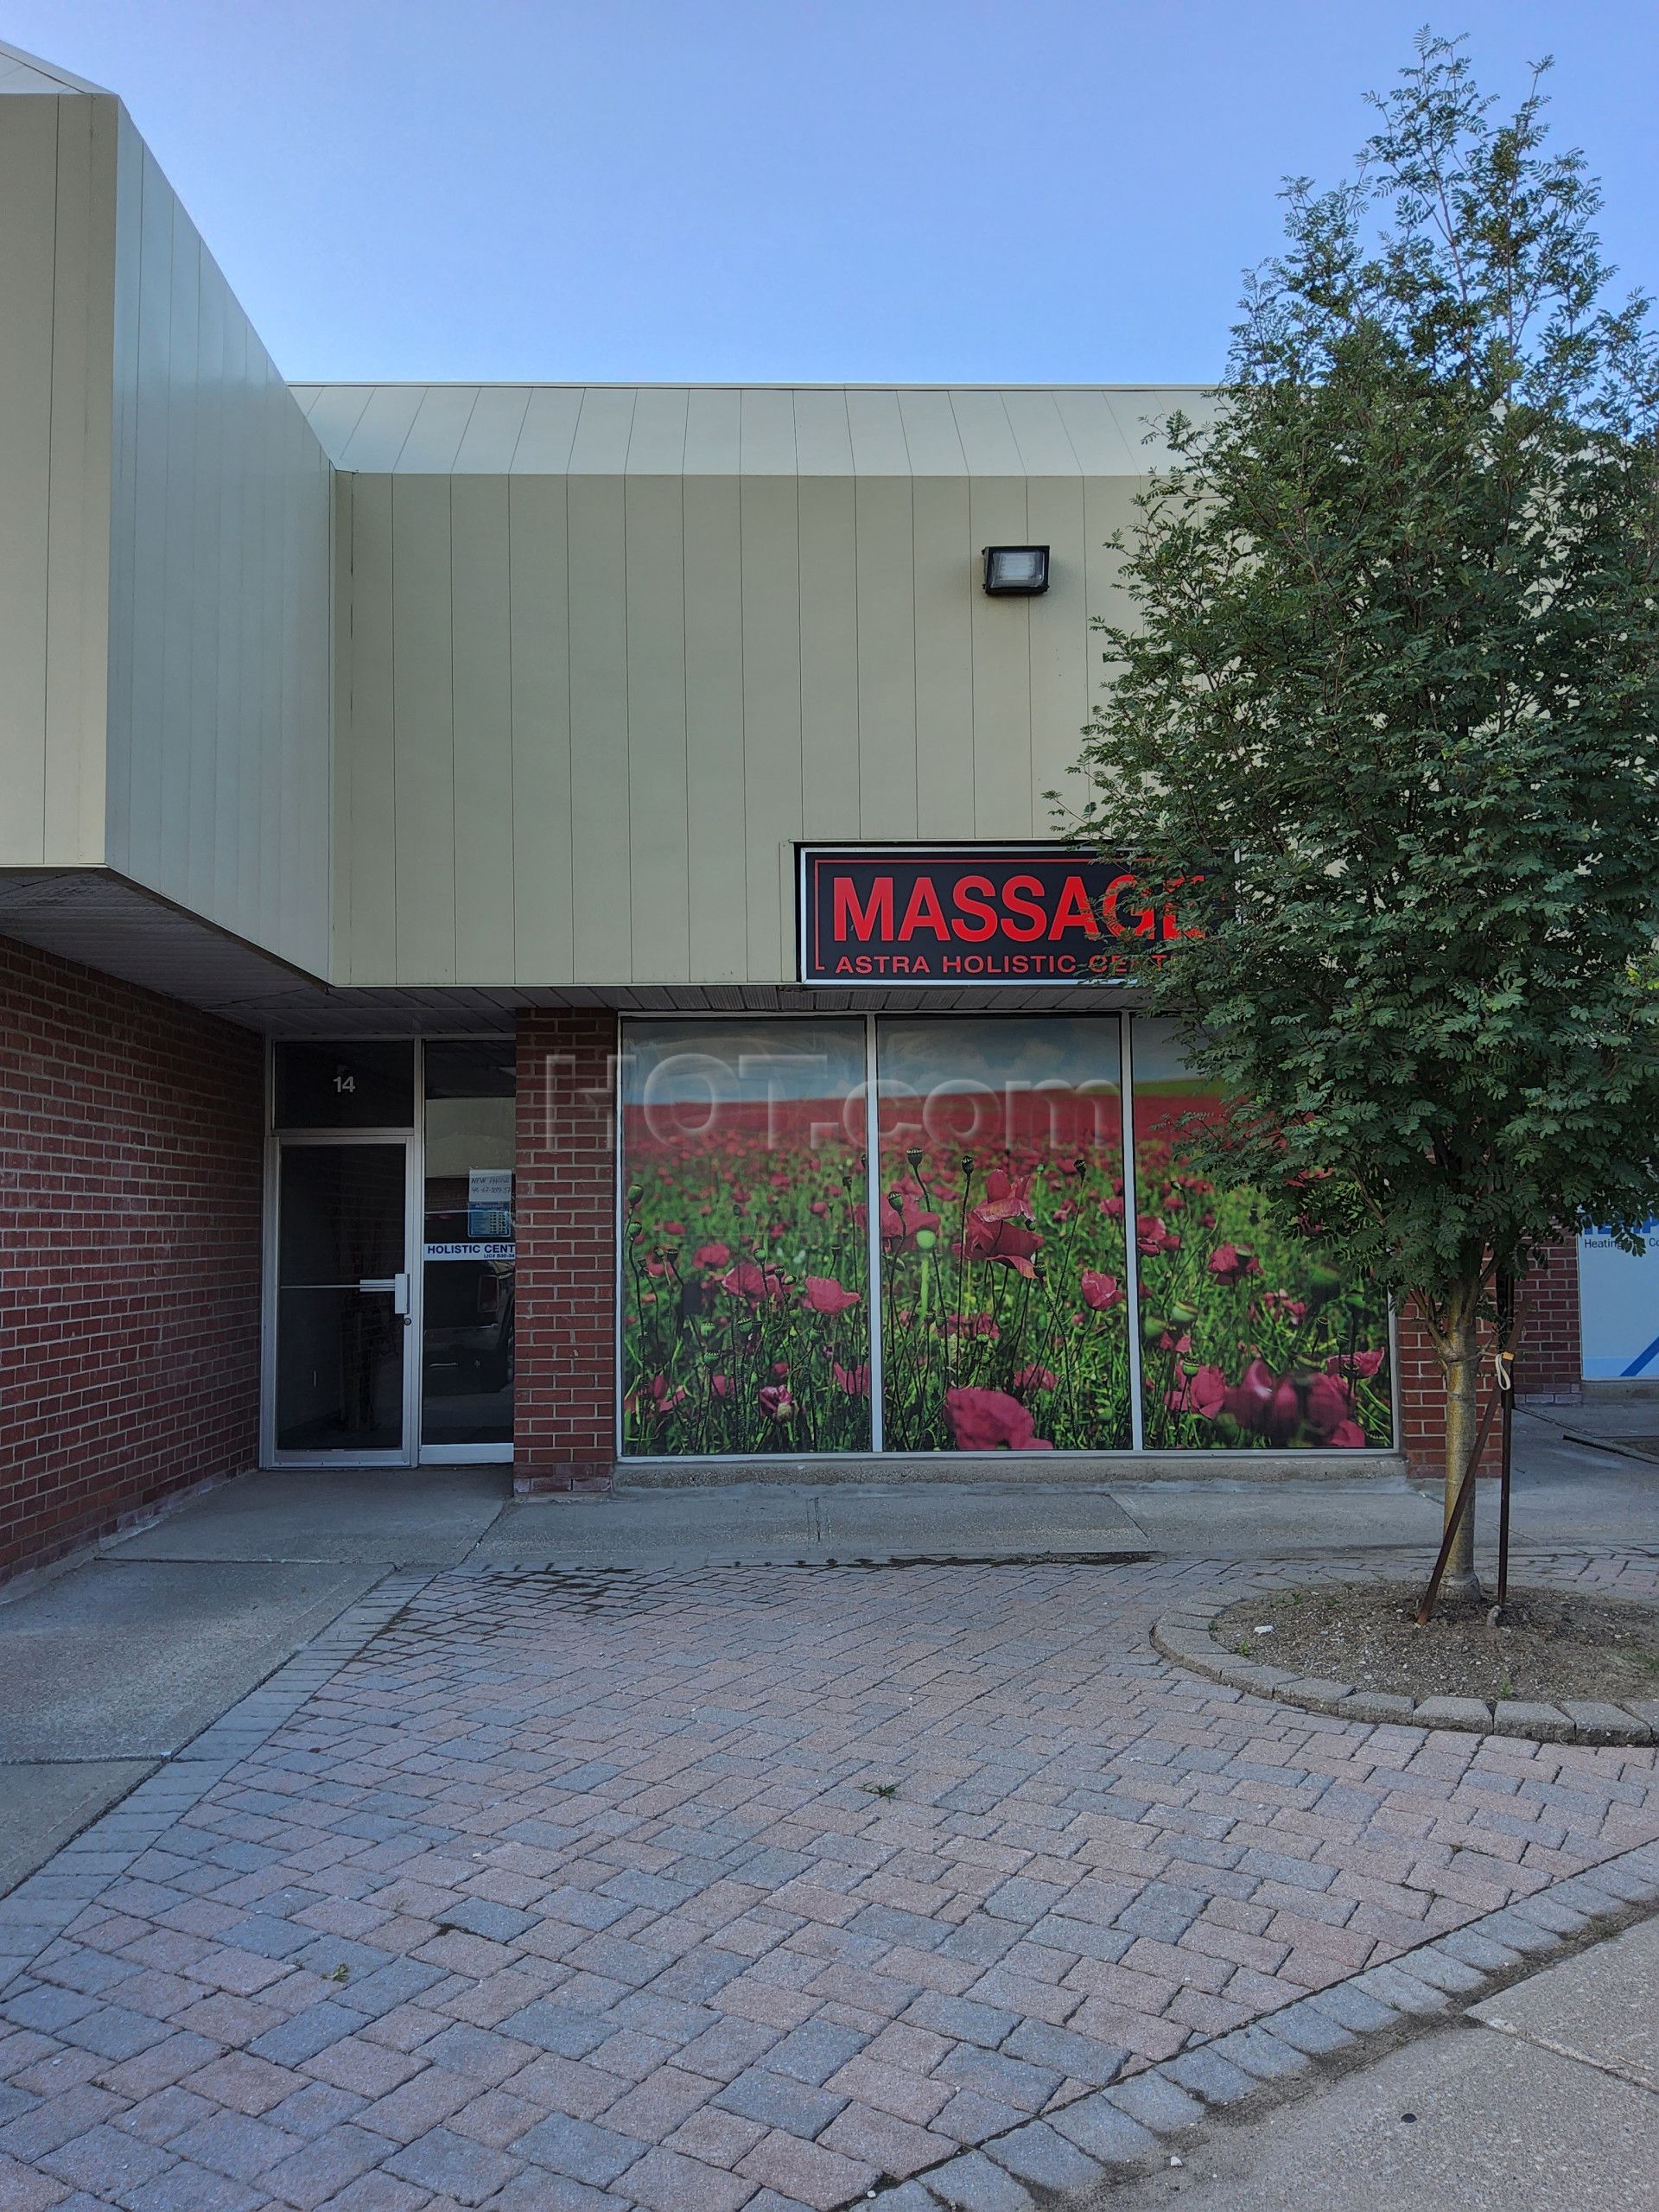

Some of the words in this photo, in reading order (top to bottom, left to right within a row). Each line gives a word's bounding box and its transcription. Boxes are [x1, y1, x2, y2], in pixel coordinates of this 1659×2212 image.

[836, 956, 931, 974] ASTRA
[942, 955, 1077, 974] HOLISTIC
[333, 1076, 356, 1093] 14
[427, 1244, 481, 1254] HOLISTIC
[484, 1244, 515, 1254] CENT
